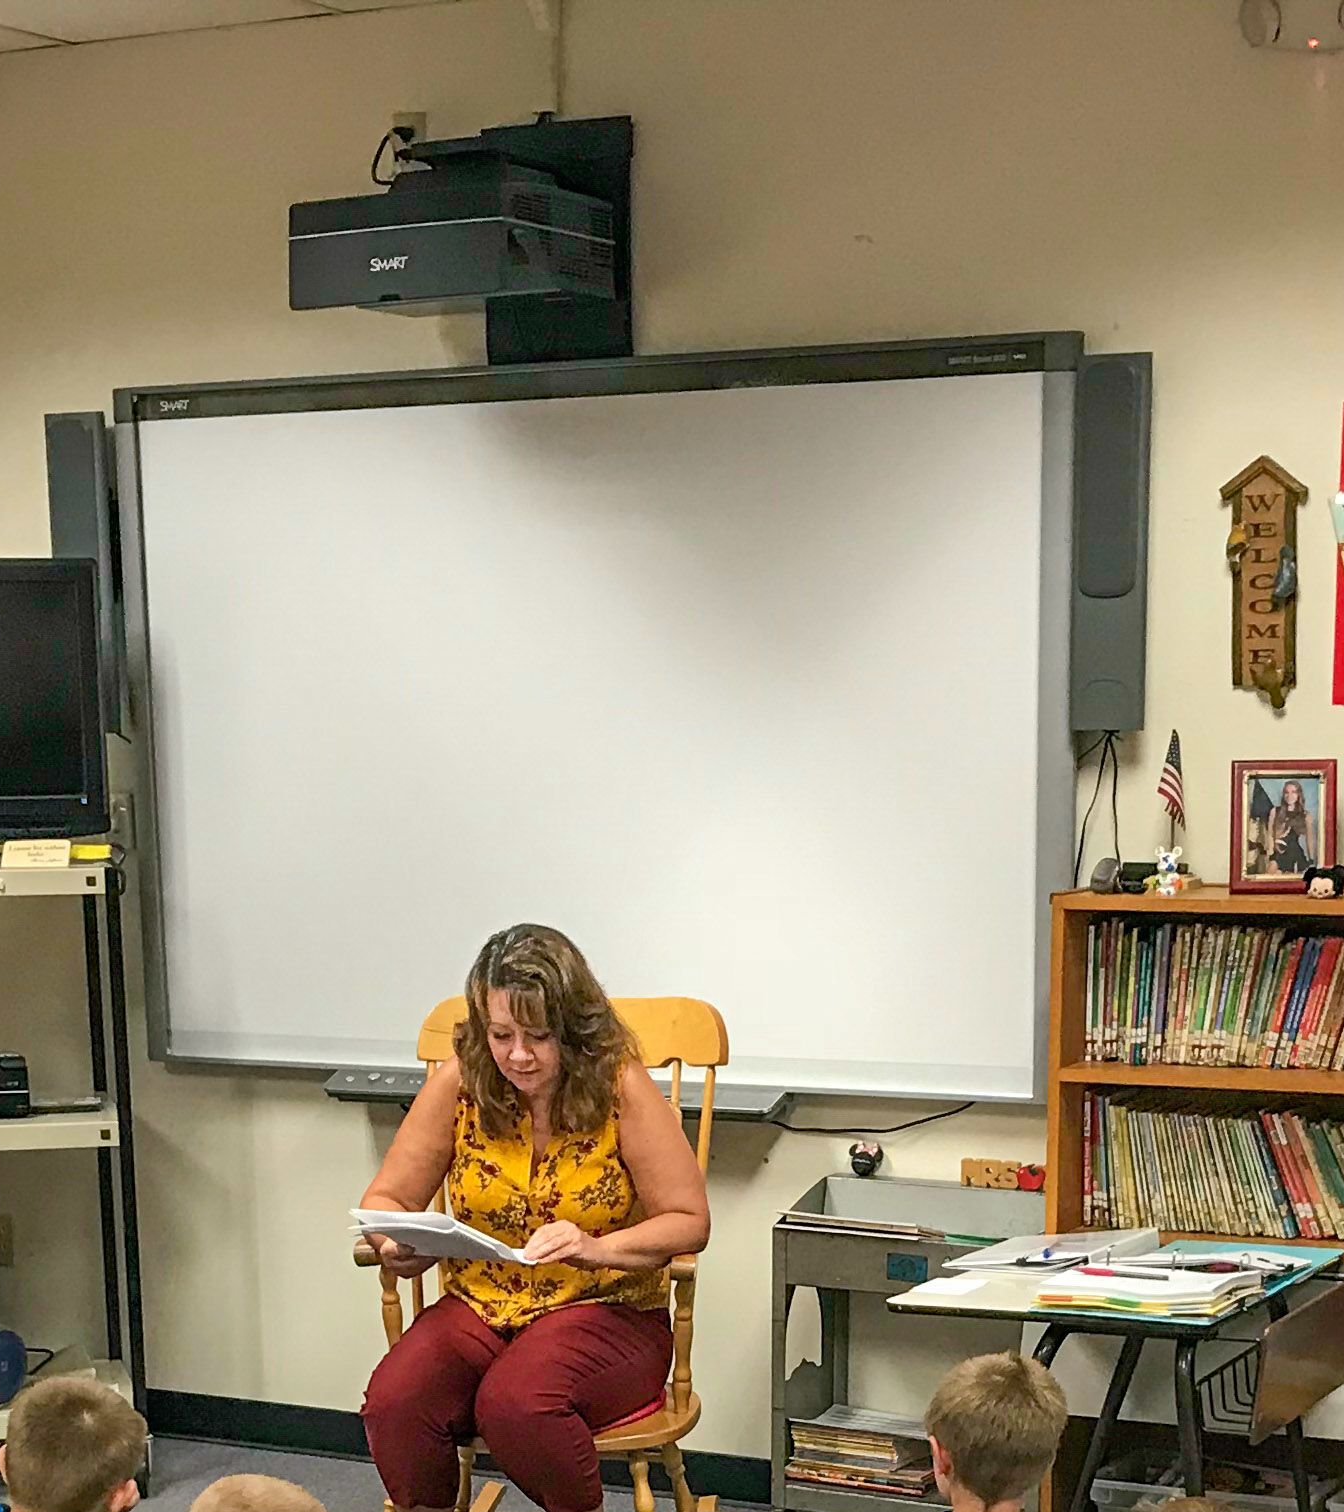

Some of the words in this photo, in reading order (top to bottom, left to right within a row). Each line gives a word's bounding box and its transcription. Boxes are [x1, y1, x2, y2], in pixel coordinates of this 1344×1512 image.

[369, 255, 409, 272] SMART
[159, 399, 190, 412] SMART
[1244, 493, 1281, 665] WELCOME
